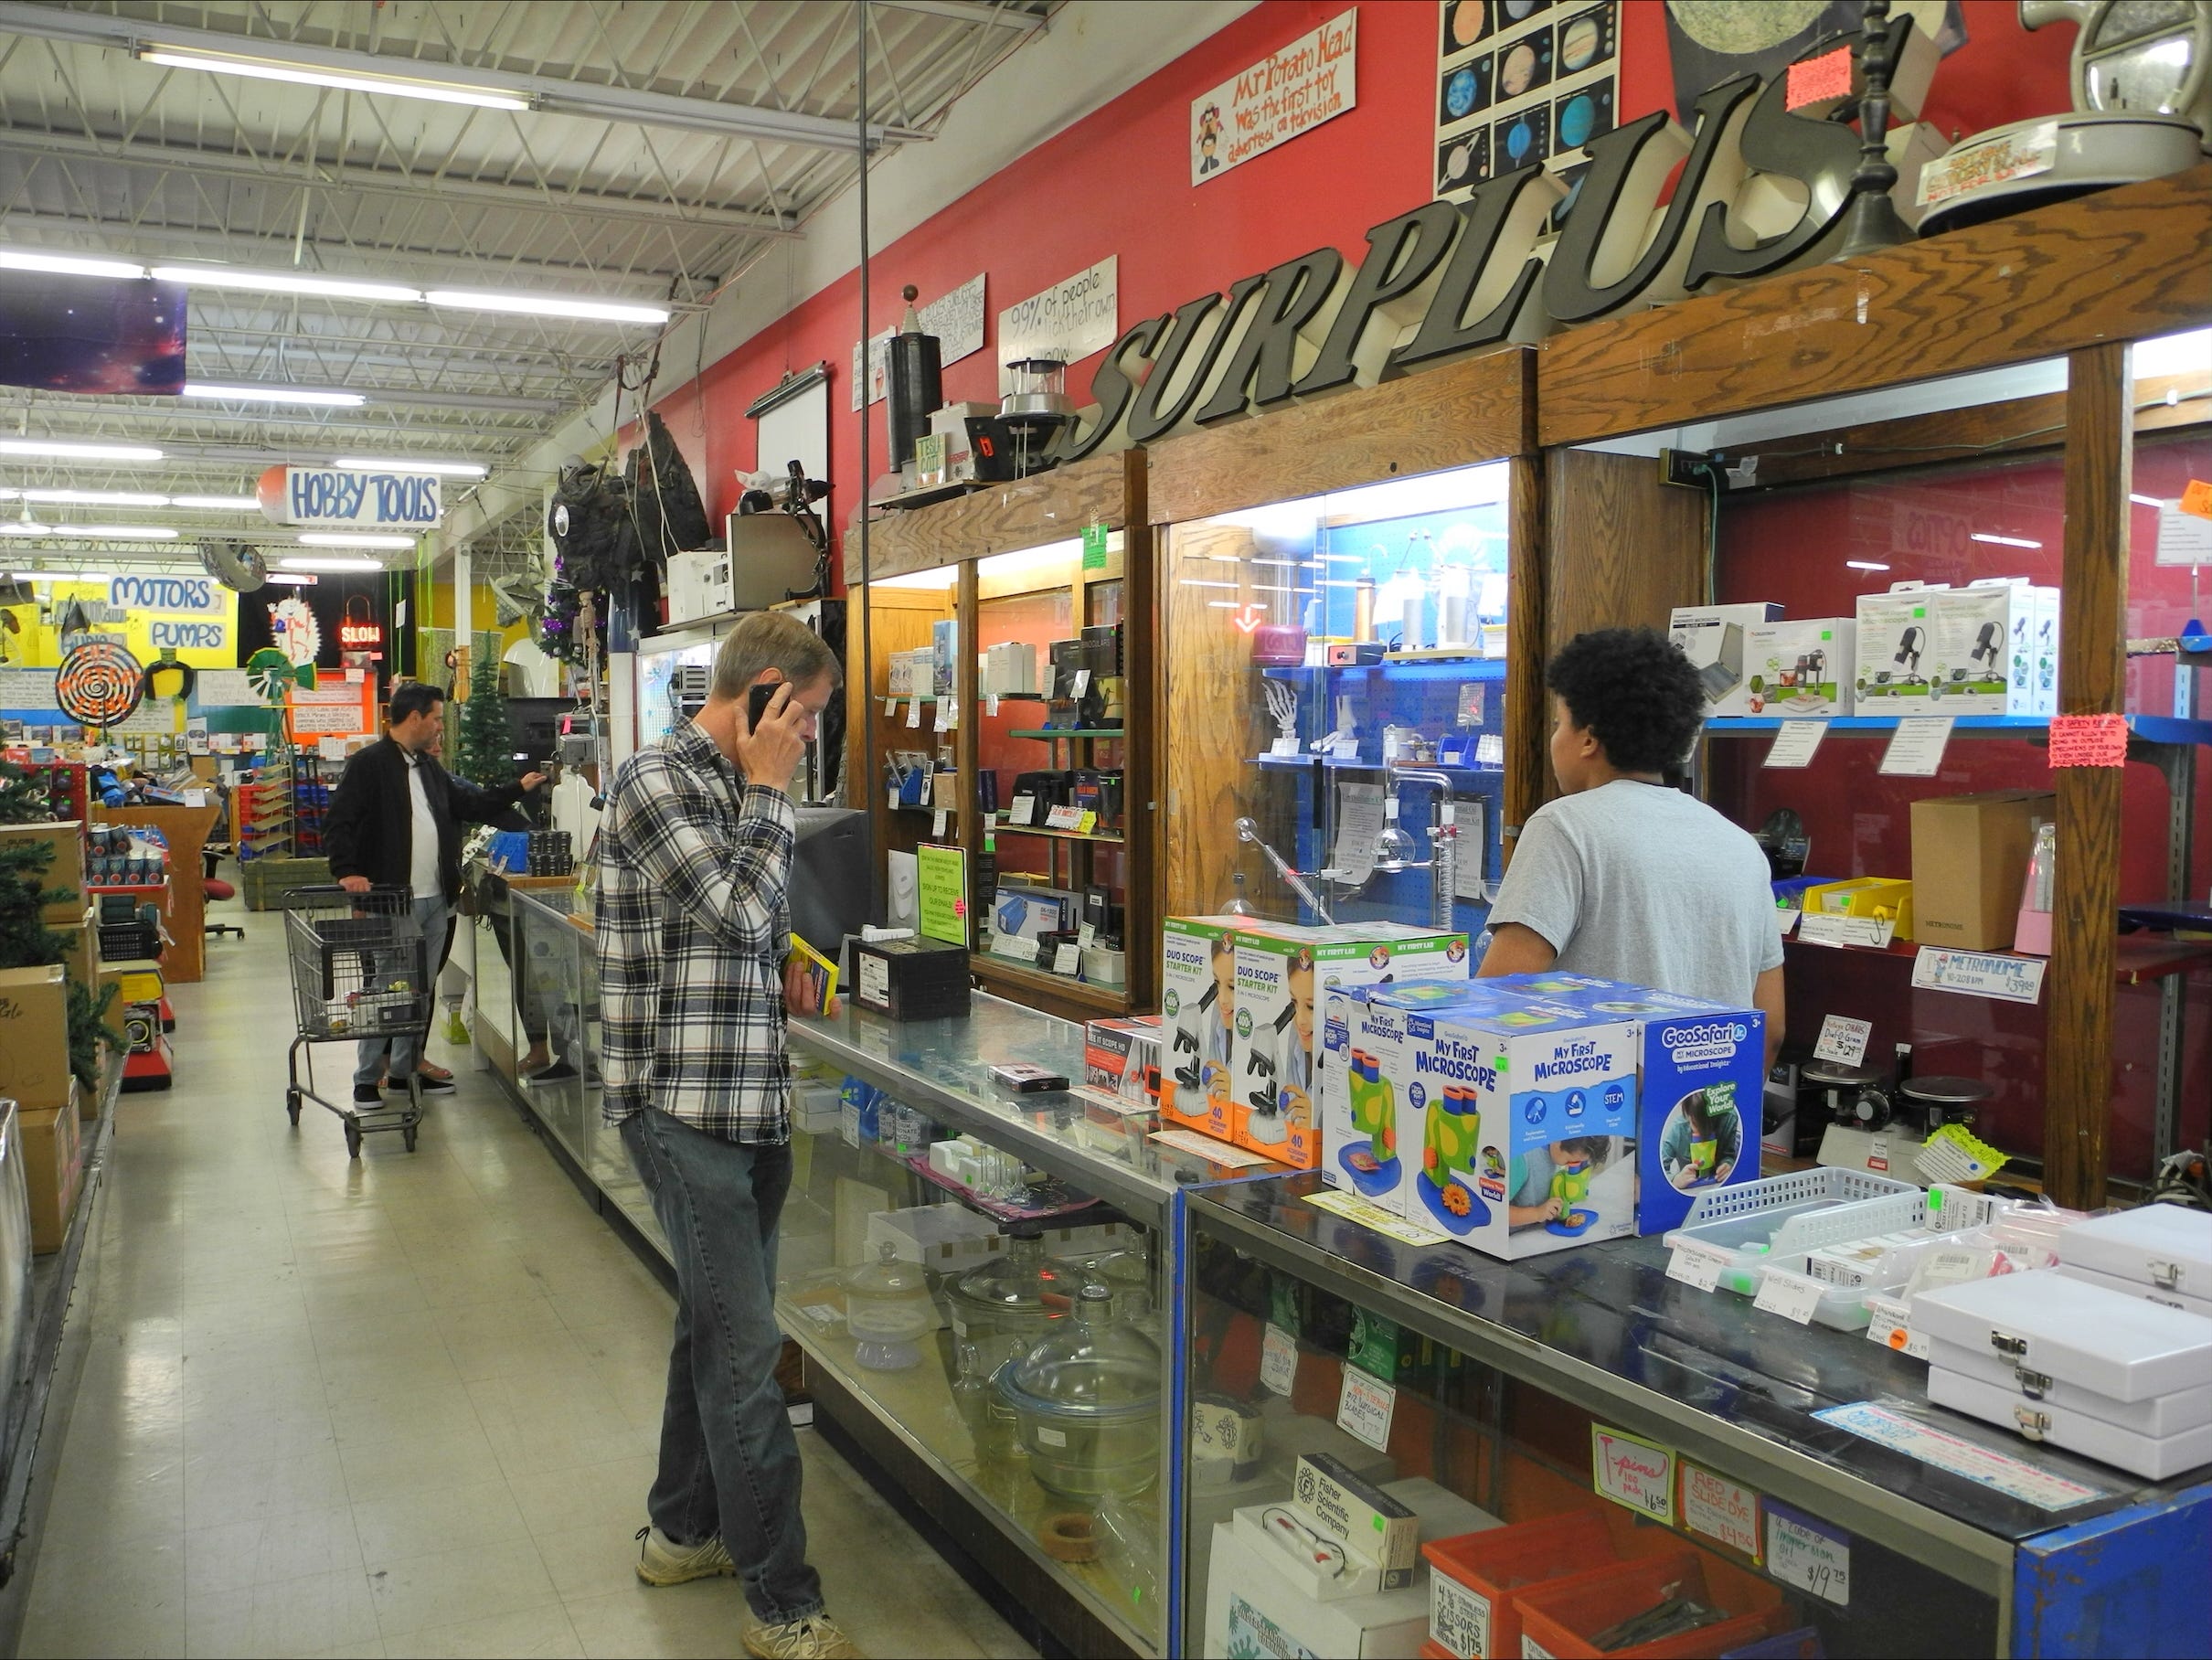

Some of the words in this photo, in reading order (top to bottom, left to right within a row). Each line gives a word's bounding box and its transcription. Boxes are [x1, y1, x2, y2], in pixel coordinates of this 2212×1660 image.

[1233, 69, 1264, 107] Mr
[1265, 48, 1314, 93] Potato
[1318, 11, 1354, 68] Head
[1236, 107, 1260, 133] was
[1262, 96, 1279, 121] the
[1281, 80, 1312, 113] first
[1316, 64, 1338, 100] toy
[1228, 123, 1274, 163] advertised
[1290, 92, 1341, 132] television
[1051, 14, 1912, 464] SURPLUS
[1012, 297, 1042, 338] 99%
[1045, 286, 1058, 317] of
[1063, 268, 1101, 316] people
[1066, 300, 1095, 331] their
[1096, 293, 1115, 317] own
[918, 433, 941, 457] TESLA
[920, 452, 941, 474] COIL
[292, 473, 367, 520] HOBBY
[368, 474, 437, 523] TOOLS
[112, 577, 210, 608] MOTORS
[152, 622, 222, 647] PUMPS
[341, 626, 380, 643] SLOW
[74, 694, 131, 715] ZONE
[1925, 920, 1963, 931] METRONOME
[1345, 947, 1356, 955] LAB
[1408, 942, 1423, 951] FIRST
[1166, 950, 1180, 960] DUO
[1182, 952, 1203, 965] SCOPE
[1166, 960, 1192, 974] STARTER
[1193, 966, 1203, 976] KIT
[1948, 954, 2026, 979] METRONOME
[1238, 965, 1253, 977] DUO
[1254, 969, 1279, 984] SCOPE
[1237, 977, 1265, 991] STARTER
[1267, 984, 1278, 995] KIT
[1361, 1021, 1404, 1044] MICROSCOPE
[1626, 1028, 1634, 1038] 3+
[1752, 1018, 1761, 1028] 3+
[1101, 1038, 1118, 1049] SCOPE
[1662, 1021, 1735, 1048] GeoSafari
[1436, 1038, 1452, 1057] My
[1452, 1040, 1480, 1063] FIRST
[1554, 1047, 1569, 1060] My
[1571, 1041, 1596, 1058] FIRST
[1686, 1047, 1732, 1059] MICROSCOPE
[1415, 1050, 1497, 1092] MICROSCOPE
[1535, 1053, 1612, 1082] MICROSCOPE
[1676, 1065, 1683, 1074] by
[1683, 1062, 1708, 1071] Educational
[1604, 1092, 1624, 1105] STEM
[1707, 1082, 1736, 1097] Explore
[1708, 1093, 1730, 1105] Your
[1212, 1105, 1223, 1120] 40
[1708, 1101, 1734, 1114] World!
[1291, 1133, 1303, 1148] 40
[1483, 1190, 1501, 1200] World!
[1358, 1395, 1385, 1421] SURGICAL
[1624, 1472, 1639, 1484] 100
[1695, 1471, 1726, 1495] RED
[1319, 1477, 1341, 1502] Fisher
[1316, 1491, 1350, 1523] Scientific
[1691, 1483, 1727, 1511] SLIDE
[1728, 1499, 1749, 1524] DYE
[1316, 1505, 1350, 1540] Company
[1437, 1601, 1481, 1639] SCISSORS
[1460, 1606, 1480, 1623] STEEL
